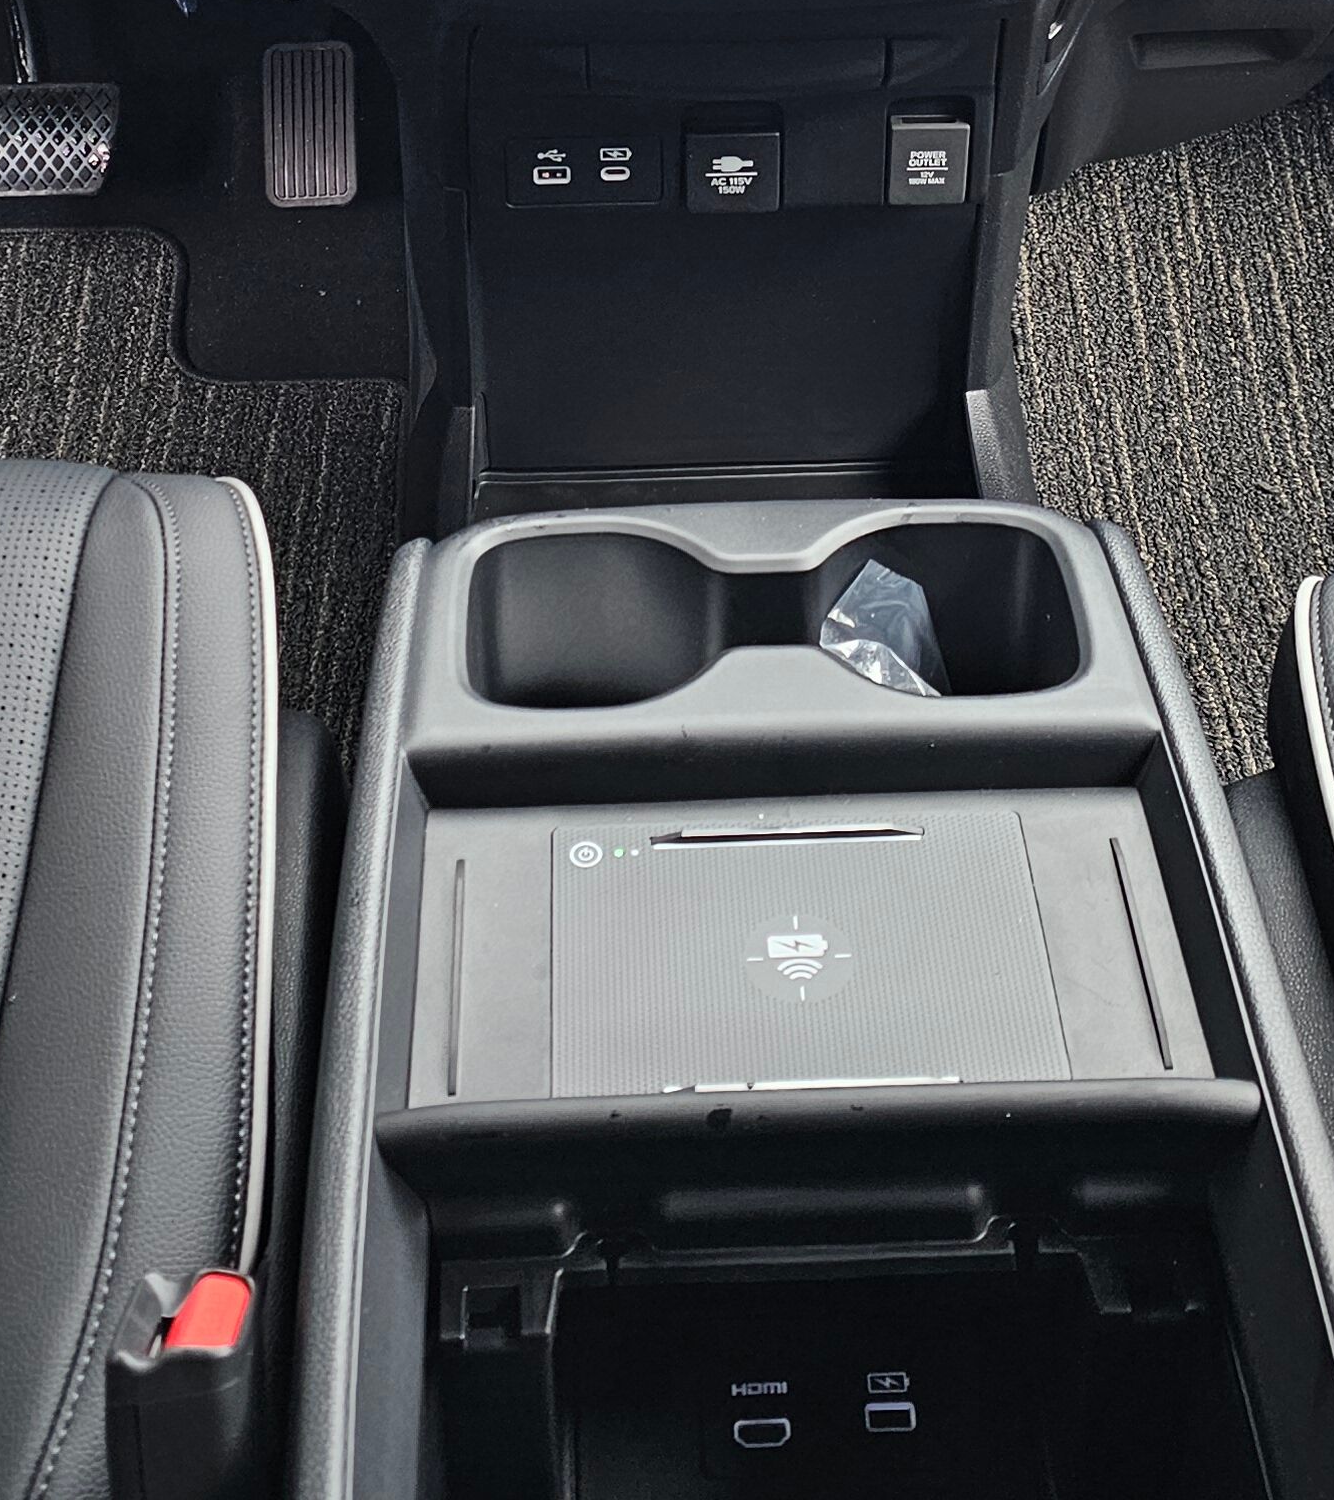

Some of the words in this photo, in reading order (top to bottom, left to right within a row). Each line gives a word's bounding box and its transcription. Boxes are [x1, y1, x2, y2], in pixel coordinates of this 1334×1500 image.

[910, 150, 946, 159] POWER
[908, 158, 947, 167] OUTLET
[711, 177, 727, 186] AC
[729, 176, 753, 186] 115V
[928, 177, 945, 185] MAX
[718, 185, 746, 194] 150W
[731, 1381, 788, 1397] HDMI
